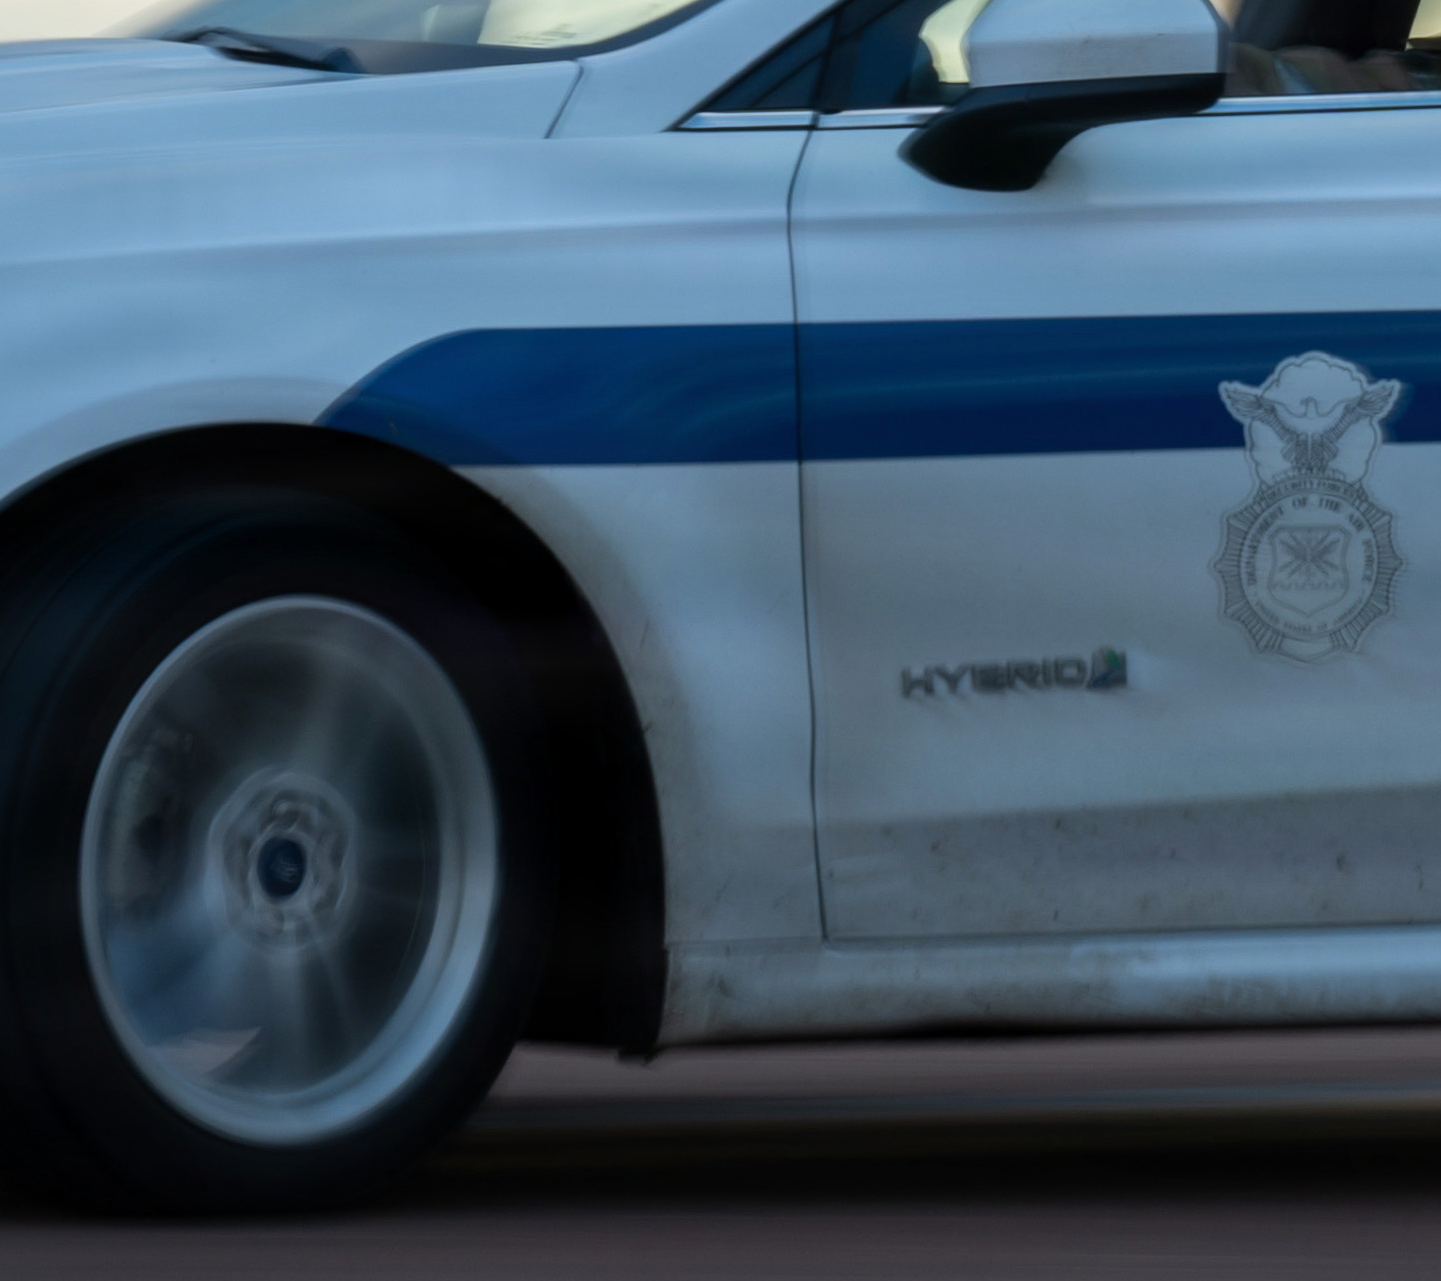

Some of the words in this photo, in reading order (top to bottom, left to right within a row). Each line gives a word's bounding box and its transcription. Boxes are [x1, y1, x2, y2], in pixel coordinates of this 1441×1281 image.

[1291, 496, 1308, 510] OF
[1319, 497, 1341, 513] THE
[1361, 538, 1375, 582] FORCE
[901, 656, 1087, 698] HYBRID
